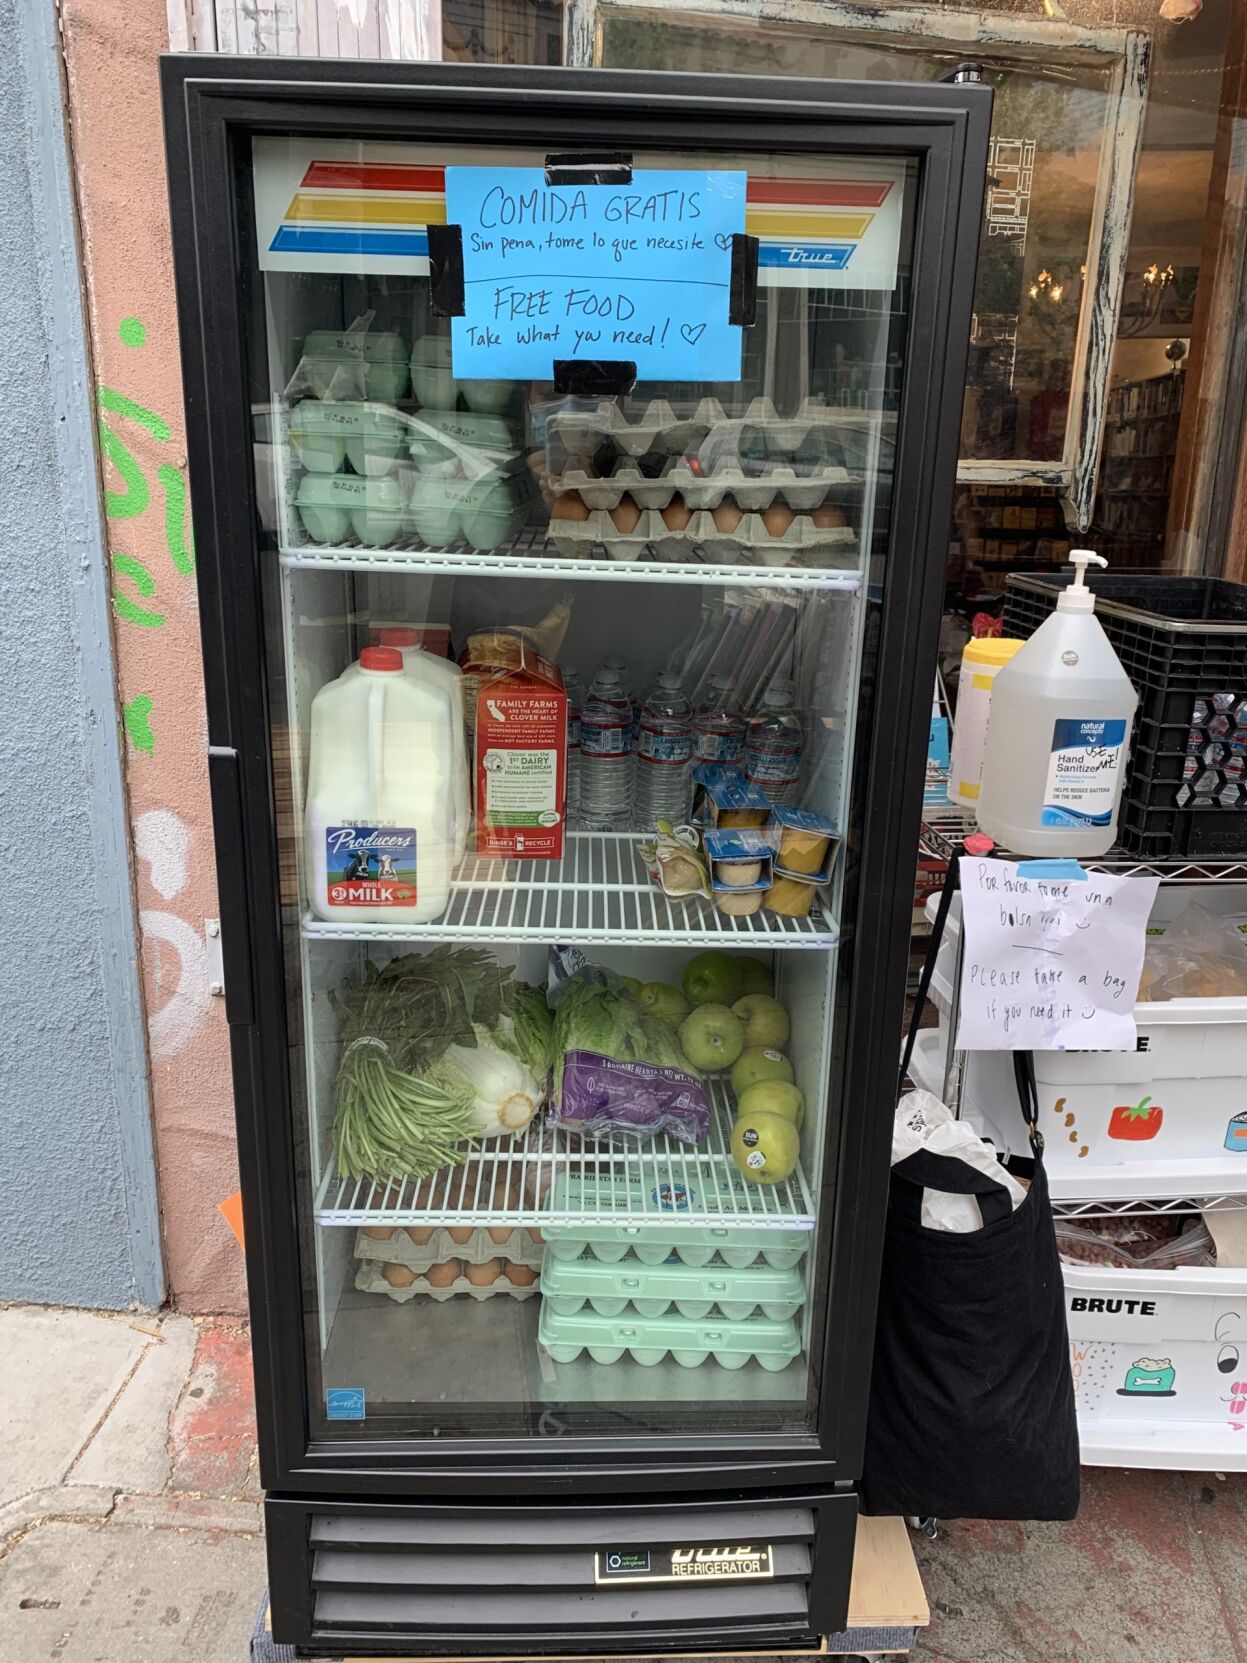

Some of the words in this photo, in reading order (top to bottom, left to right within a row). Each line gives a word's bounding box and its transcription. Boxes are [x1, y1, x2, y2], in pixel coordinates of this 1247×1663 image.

[479, 185, 588, 229] COMIDA
[604, 189, 701, 224] GRATIS
[470, 233, 494, 253] Sin
[545, 235, 584, 250] tome
[592, 232, 605, 248] lo
[611, 237, 638, 262] que
[646, 233, 705, 250] necesite
[493, 286, 552, 321] FREE
[564, 289, 635, 321] FOOD
[466, 326, 501, 347] Take
[516, 323, 560, 344] what
[575, 329, 601, 354] you
[496, 700, 528, 708] FAMILY
[529, 700, 558, 708] FARMS
[1080, 722, 1105, 730] natural
[1085, 743, 1107, 758] USE
[521, 757, 549, 765] DAIRY
[1057, 755, 1085, 764] Hand
[1056, 763, 1100, 773] Sanitizer
[327, 828, 412, 854] Producers
[348, 888, 394, 901] MILK
[1037, 882, 1069, 898] tome
[970, 964, 1021, 987] Please
[1034, 967, 1063, 984] take
[1078, 974, 1088, 986] a
[1103, 971, 1126, 999] bag
[986, 998, 997, 1019] if
[1030, 1003, 1054, 1019] need
[1062, 1004, 1073, 1018] it
[607, 1062, 635, 1073] ROMAINE
[1070, 1297, 1157, 1316] BRUTE
[671, 1560, 761, 1576] REFRIGERATOR
